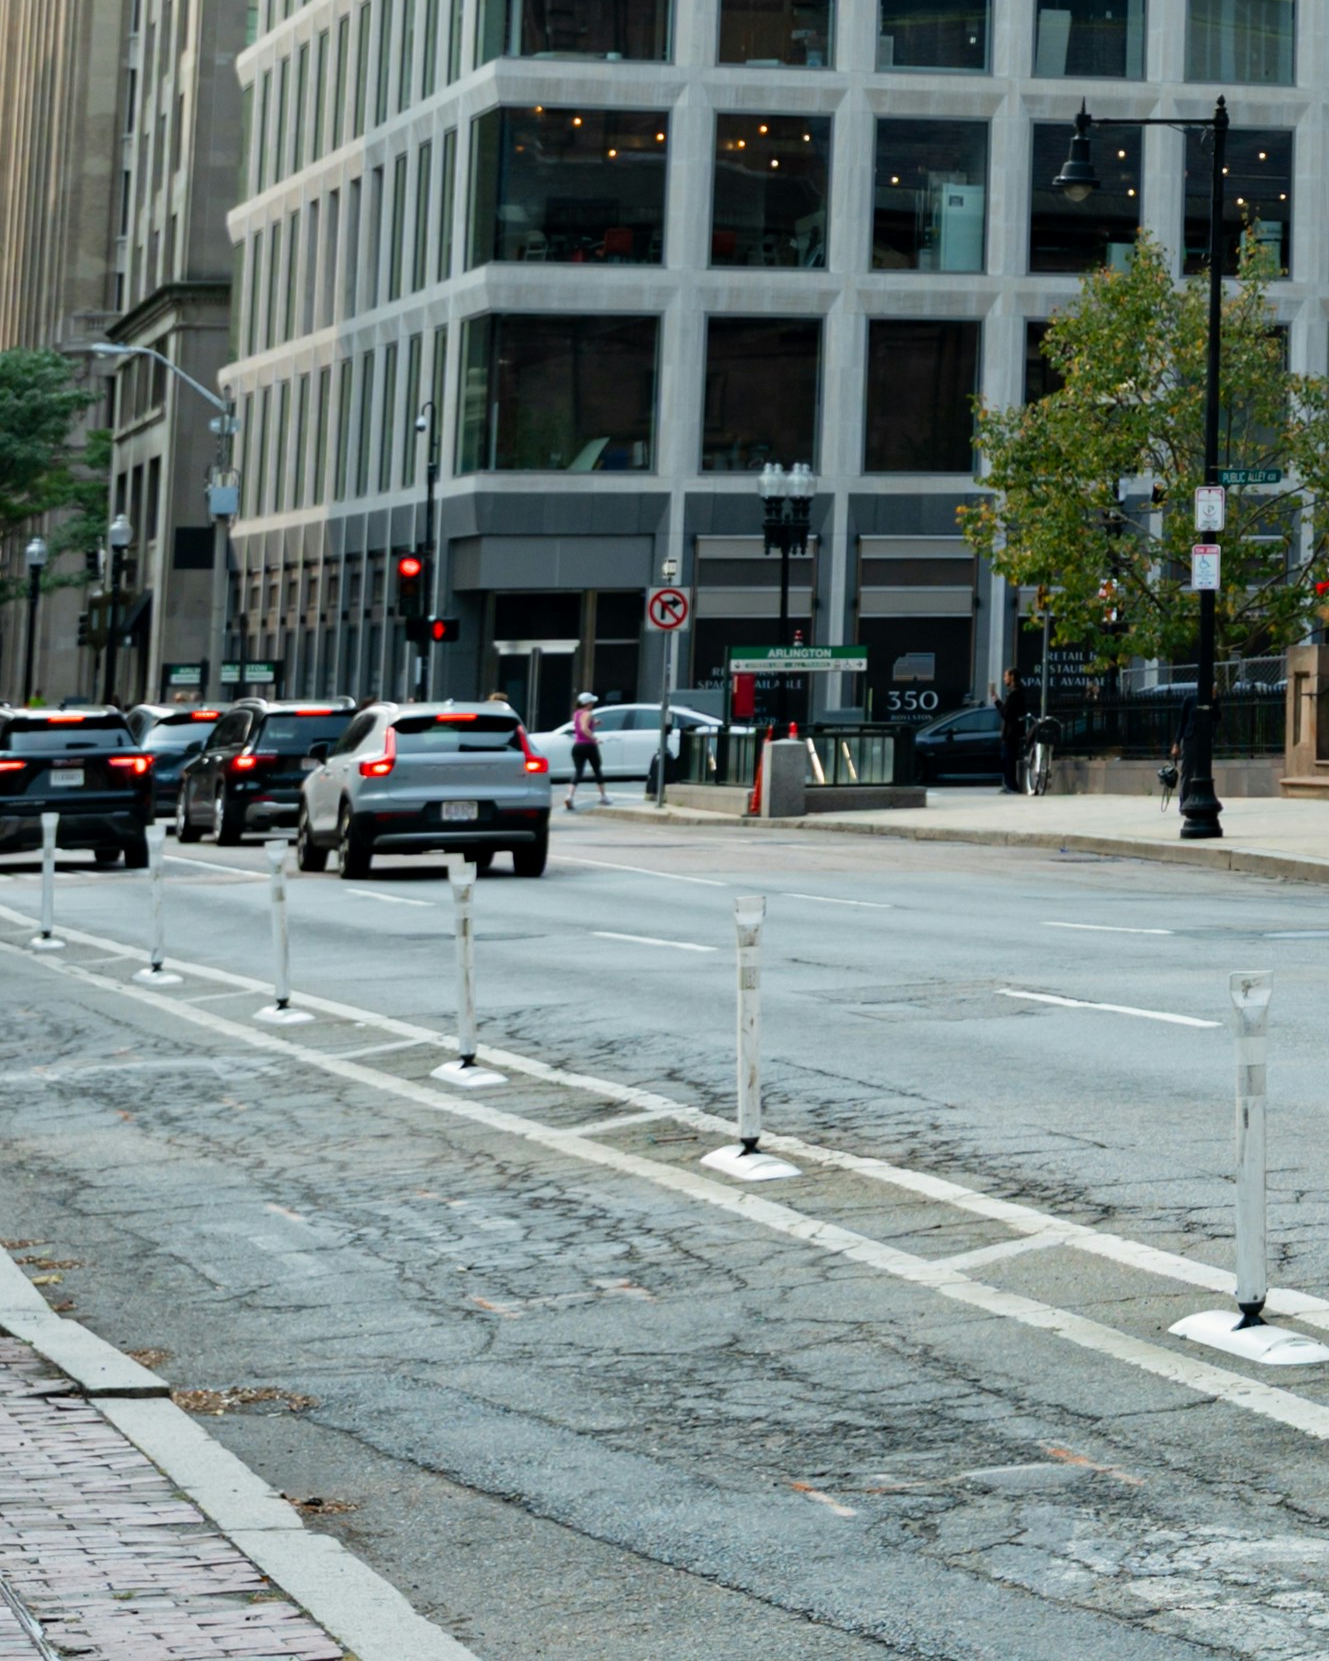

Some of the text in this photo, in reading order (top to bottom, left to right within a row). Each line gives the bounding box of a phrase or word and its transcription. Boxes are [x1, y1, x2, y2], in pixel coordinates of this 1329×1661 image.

[1222, 472, 1247, 483] PUBLIC
[1248, 472, 1266, 482] ALLEY
[767, 648, 832, 658] ARLINGTON
[1047, 651, 1084, 662] RETAIL
[887, 690, 939, 711] 350
